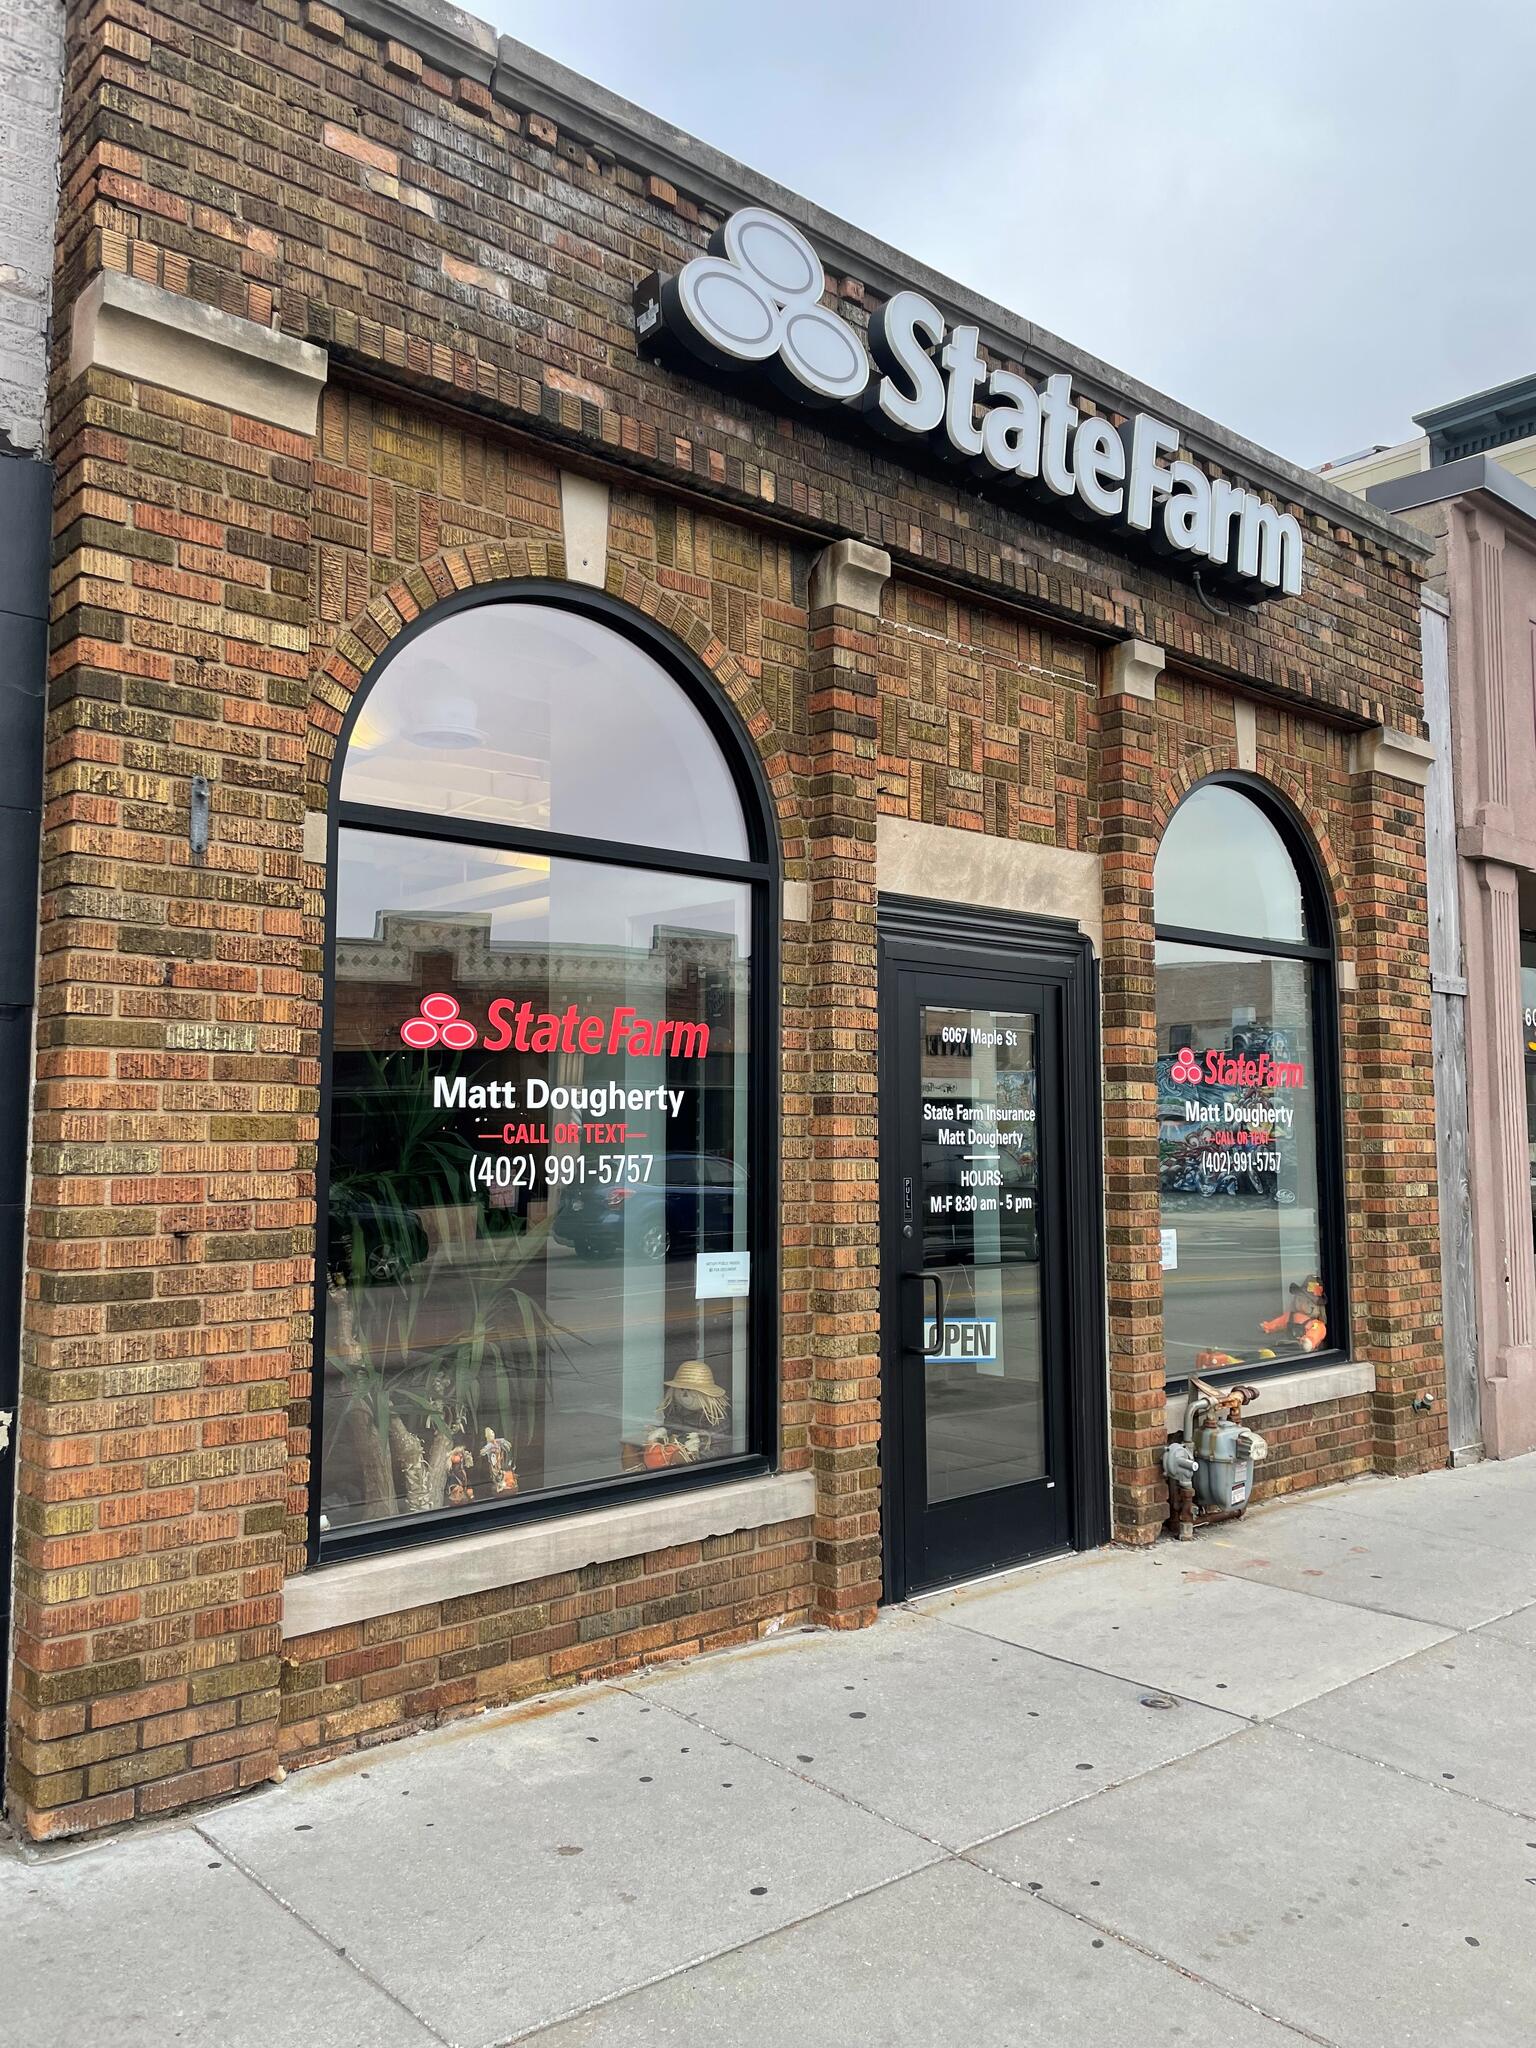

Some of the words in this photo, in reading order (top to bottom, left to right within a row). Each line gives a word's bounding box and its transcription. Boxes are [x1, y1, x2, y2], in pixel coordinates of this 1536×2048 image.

[942, 1026, 968, 1044] 6067
[970, 1027, 1003, 1048] Maple
[1005, 1030, 1018, 1046] St
[433, 1075, 516, 1110] Matt
[526, 1078, 685, 1118] Dougherty
[923, 1103, 954, 1121] State
[956, 1104, 983, 1121] Farm
[986, 1105, 1036, 1122] Insurance
[1185, 1100, 1221, 1122] Matt
[1224, 1102, 1294, 1128] Dougherty
[503, 1123, 549, 1144] CALL
[554, 1123, 579, 1144] OR
[584, 1123, 628, 1144] TEXT
[938, 1128, 966, 1146] Matt
[967, 1129, 1023, 1148] Dougherty
[1215, 1131, 1235, 1145] CALL
[1236, 1131, 1247, 1145] OR
[1249, 1131, 1269, 1145] TEXT
[469, 1153, 536, 1192] (402)
[544, 1154, 654, 1185] 991-5757
[1202, 1151, 1231, 1175] (402)
[1233, 1152, 1282, 1173] 991-5757
[960, 1170, 1004, 1187] HOURS:
[930, 1196, 953, 1213] M-F
[955, 1195, 978, 1211] 8:30
[979, 1198, 997, 1211] am
[1006, 1194, 1013, 1210] 5
[1014, 1195, 1032, 1213] pm
